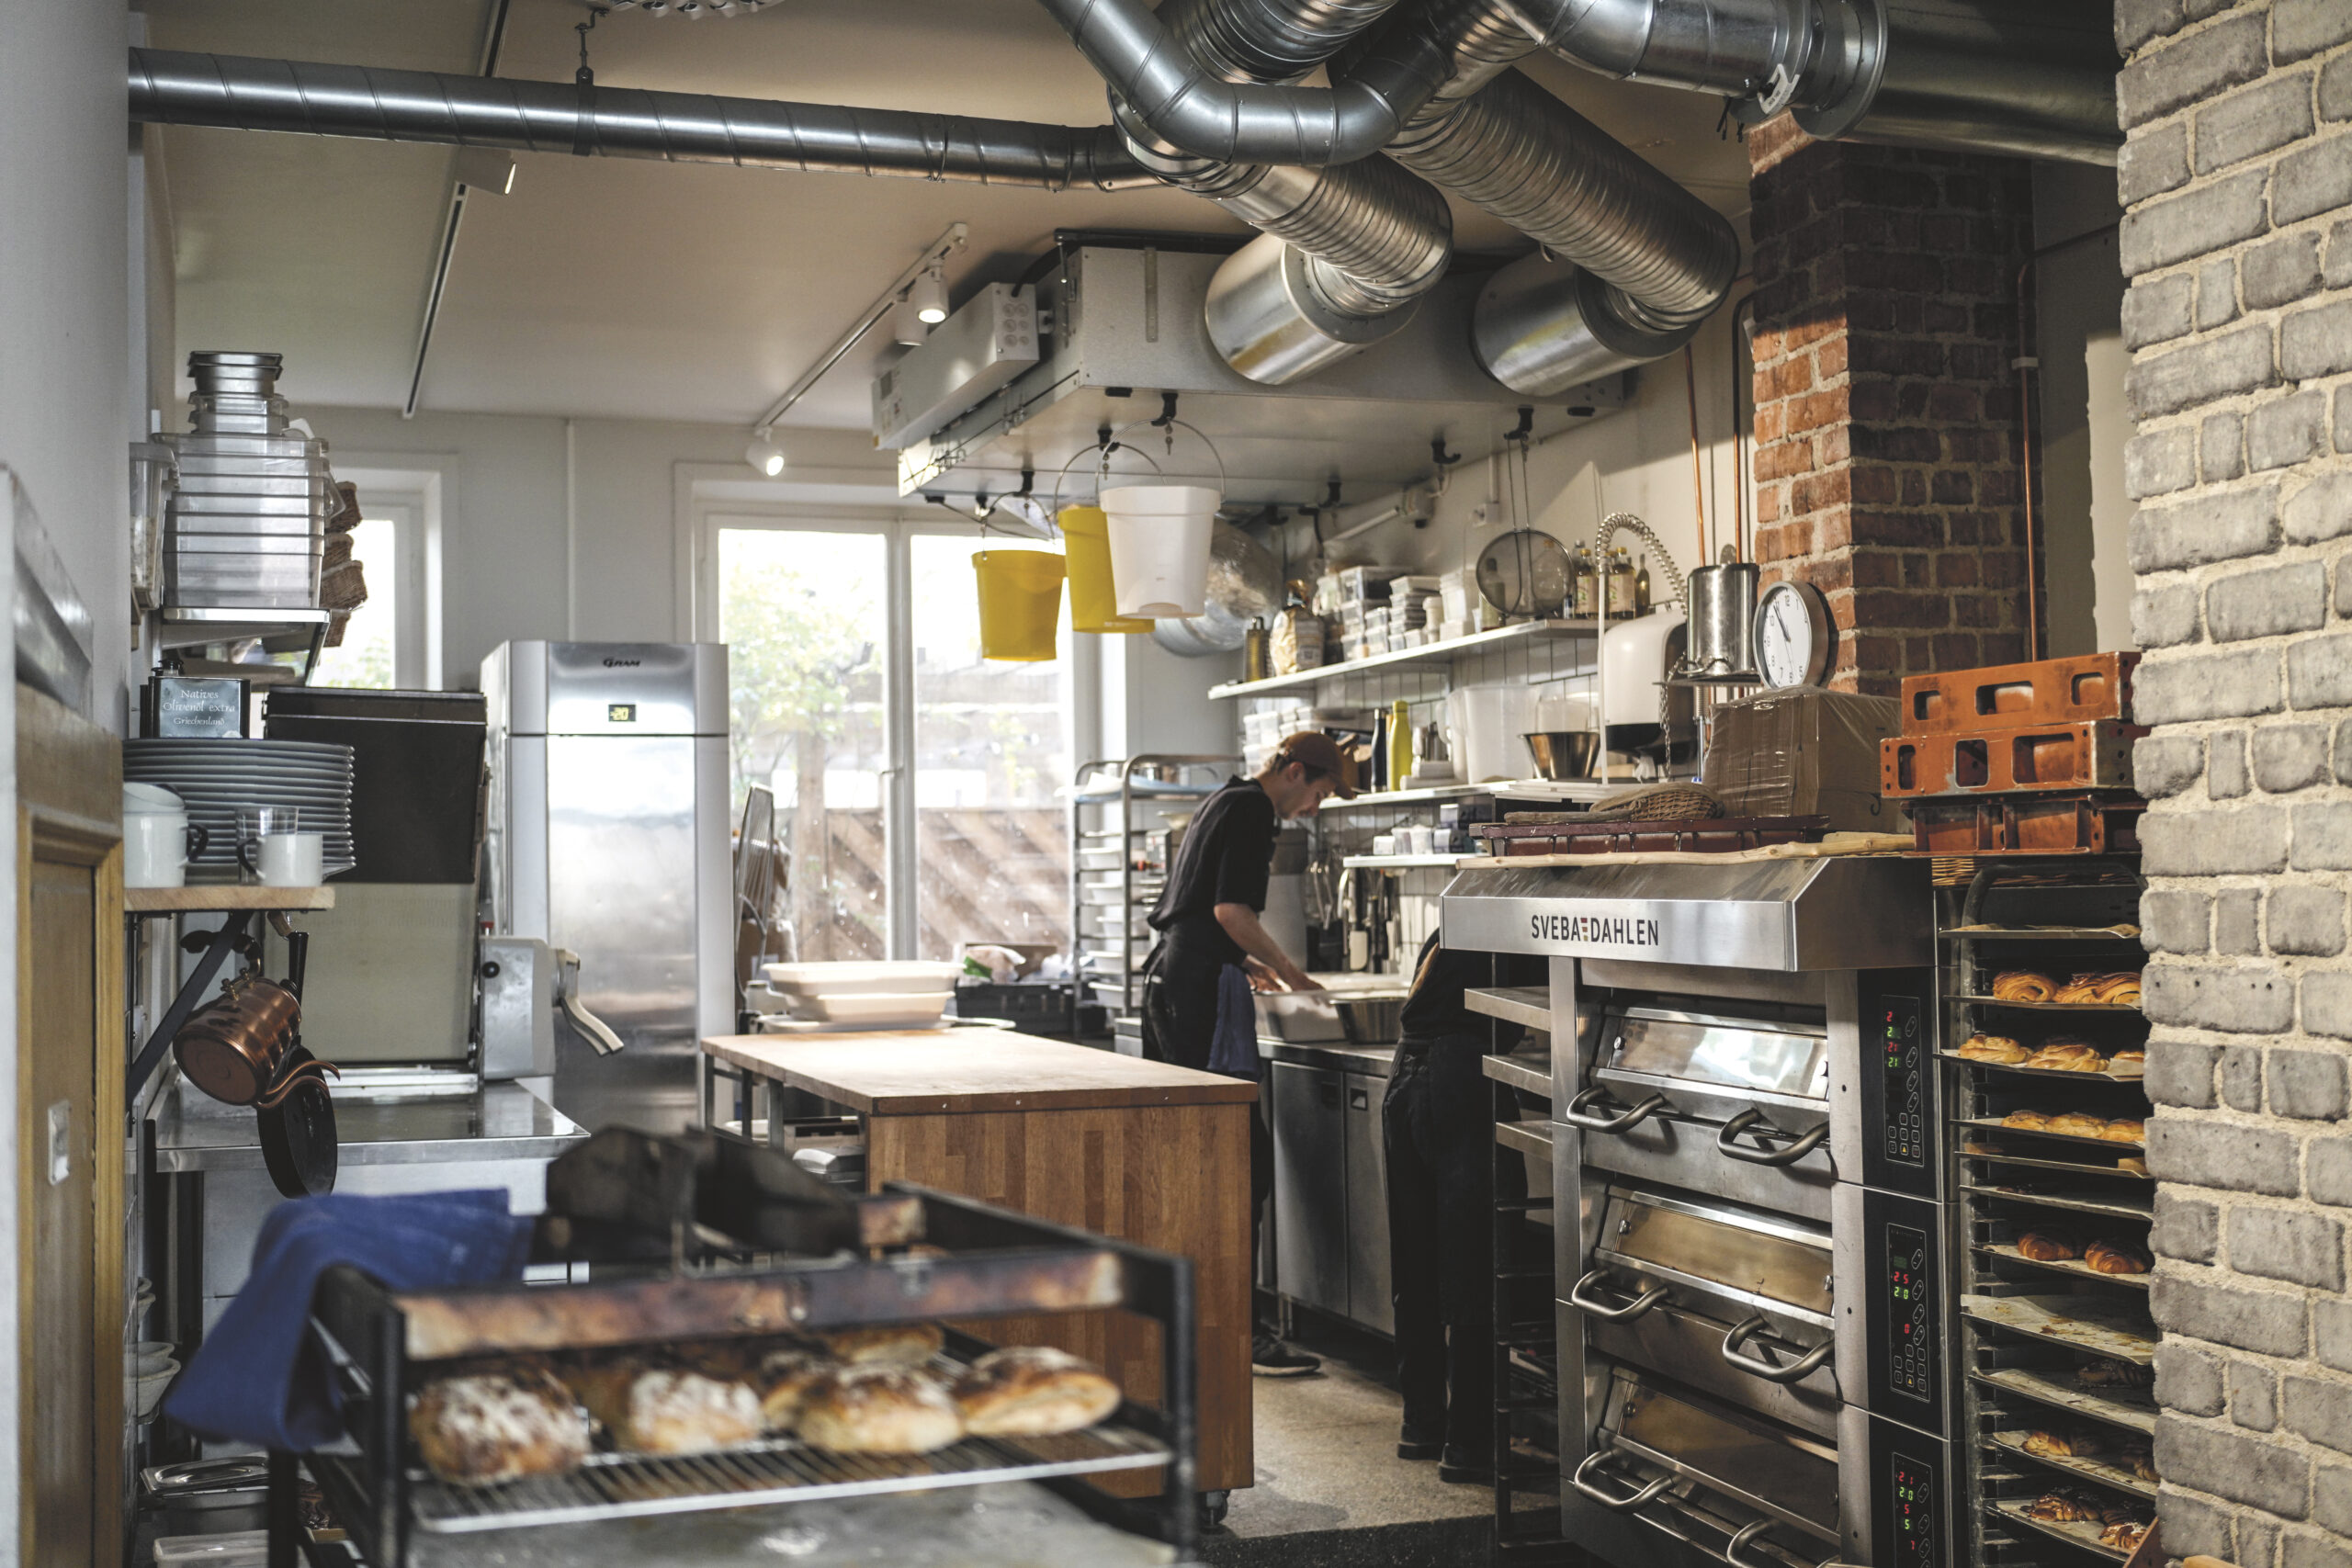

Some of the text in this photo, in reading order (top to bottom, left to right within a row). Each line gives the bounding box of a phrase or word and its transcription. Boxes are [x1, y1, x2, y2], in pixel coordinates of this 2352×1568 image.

[180, 689, 219, 699] Natives
[163, 699, 204, 712] Olivenöl
[173, 716, 225, 726] Griechenland
[1532, 914, 1658, 946] SVEBA DAHLEN
